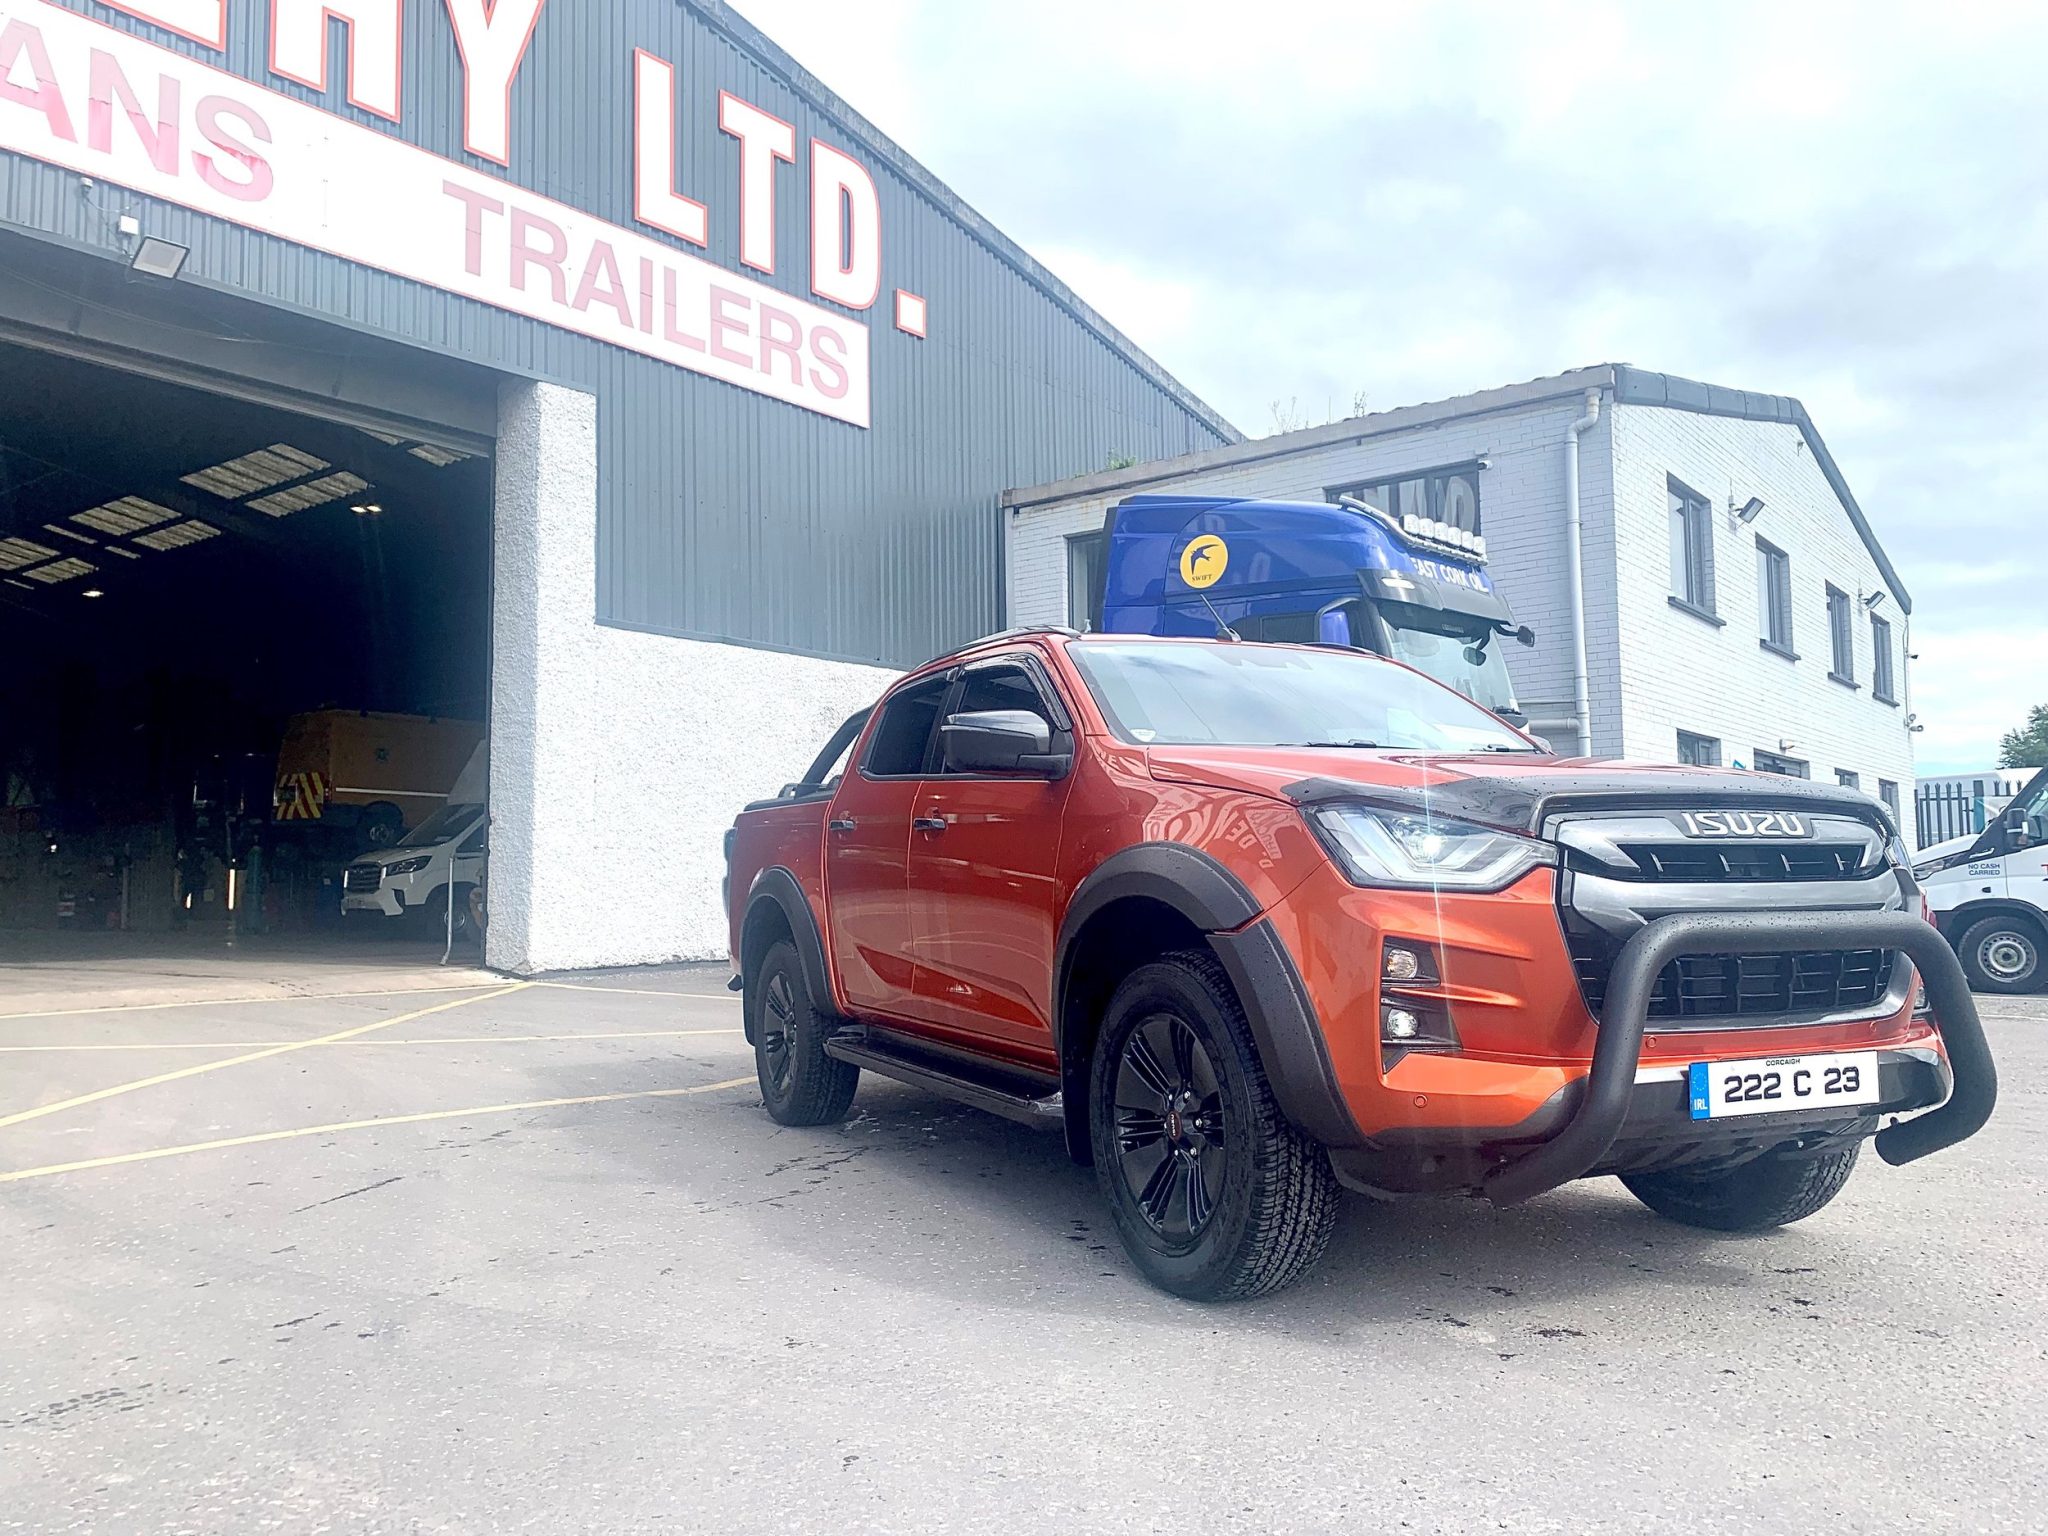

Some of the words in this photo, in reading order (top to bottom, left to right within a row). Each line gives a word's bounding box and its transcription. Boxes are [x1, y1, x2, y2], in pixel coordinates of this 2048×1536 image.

[634, 46, 927, 339] LTD.
[0, 17, 274, 202] ANS
[441, 179, 849, 399] TRAILERS
[1192, 574, 1212, 582] SWIFT
[1681, 811, 1805, 836] ISUZU
[1765, 1058, 1801, 1067] CORCAIGH
[1724, 1072, 1782, 1103] 222
[1793, 1070, 1811, 1097] C
[1823, 1066, 1860, 1094] 23
[1694, 1098, 1708, 1110] IRL
